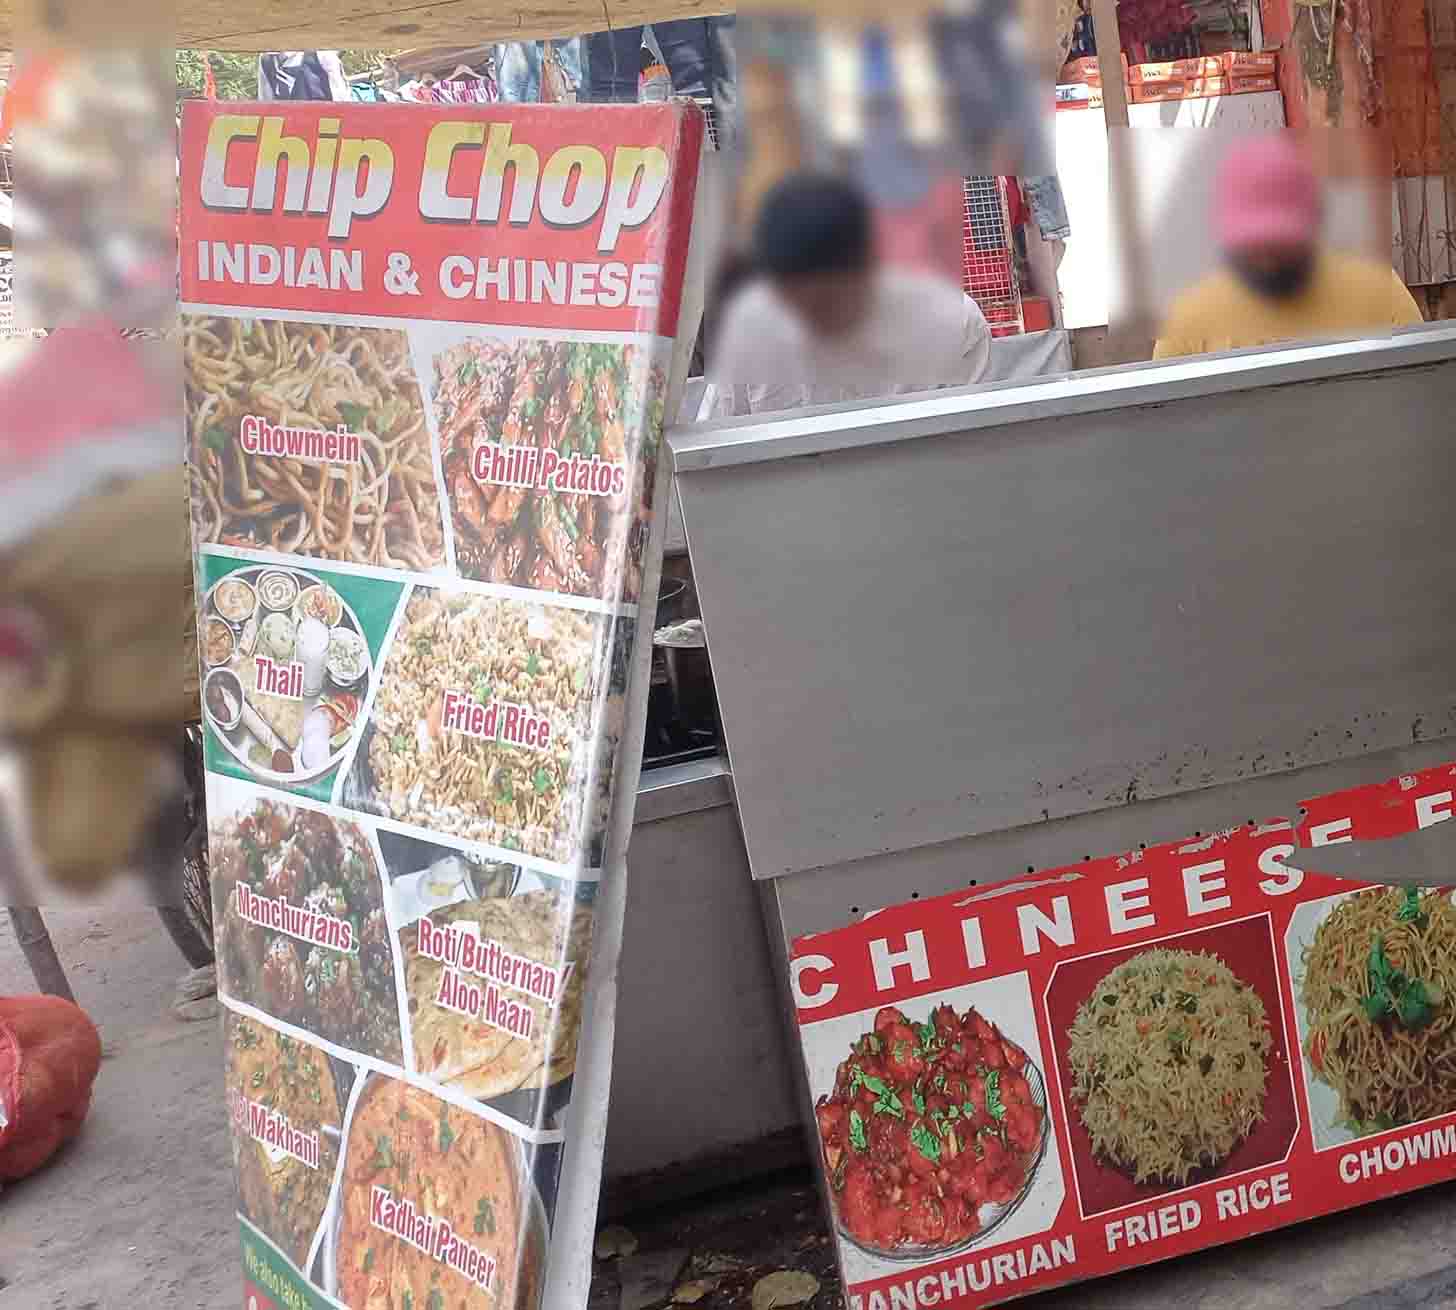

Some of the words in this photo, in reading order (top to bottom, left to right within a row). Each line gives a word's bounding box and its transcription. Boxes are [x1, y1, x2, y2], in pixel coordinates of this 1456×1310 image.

[200, 115, 394, 238] Chip
[418, 120, 668, 252] Chop
[198, 241, 362, 291] INDIAN
[384, 253, 420, 296] &
[439, 255, 662, 308] CHINESE
[241, 417, 360, 462] Chowmein
[474, 445, 536, 485] Chilli
[541, 452, 624, 494] Patatos
[255, 657, 304, 698] Thali
[443, 693, 498, 737] Fried
[503, 705, 550, 748] Rice
[237, 884, 352, 950] Manchurians
[439, 968, 479, 1015] Aloo
[486, 986, 532, 1037] Naan
[249, 1103, 319, 1168] Makhani
[373, 1189, 433, 1252] Kadhai
[435, 1222, 495, 1287] Paneer
[1105, 1200, 1201, 1252] FRIED
[1216, 1173, 1292, 1220] RICE
